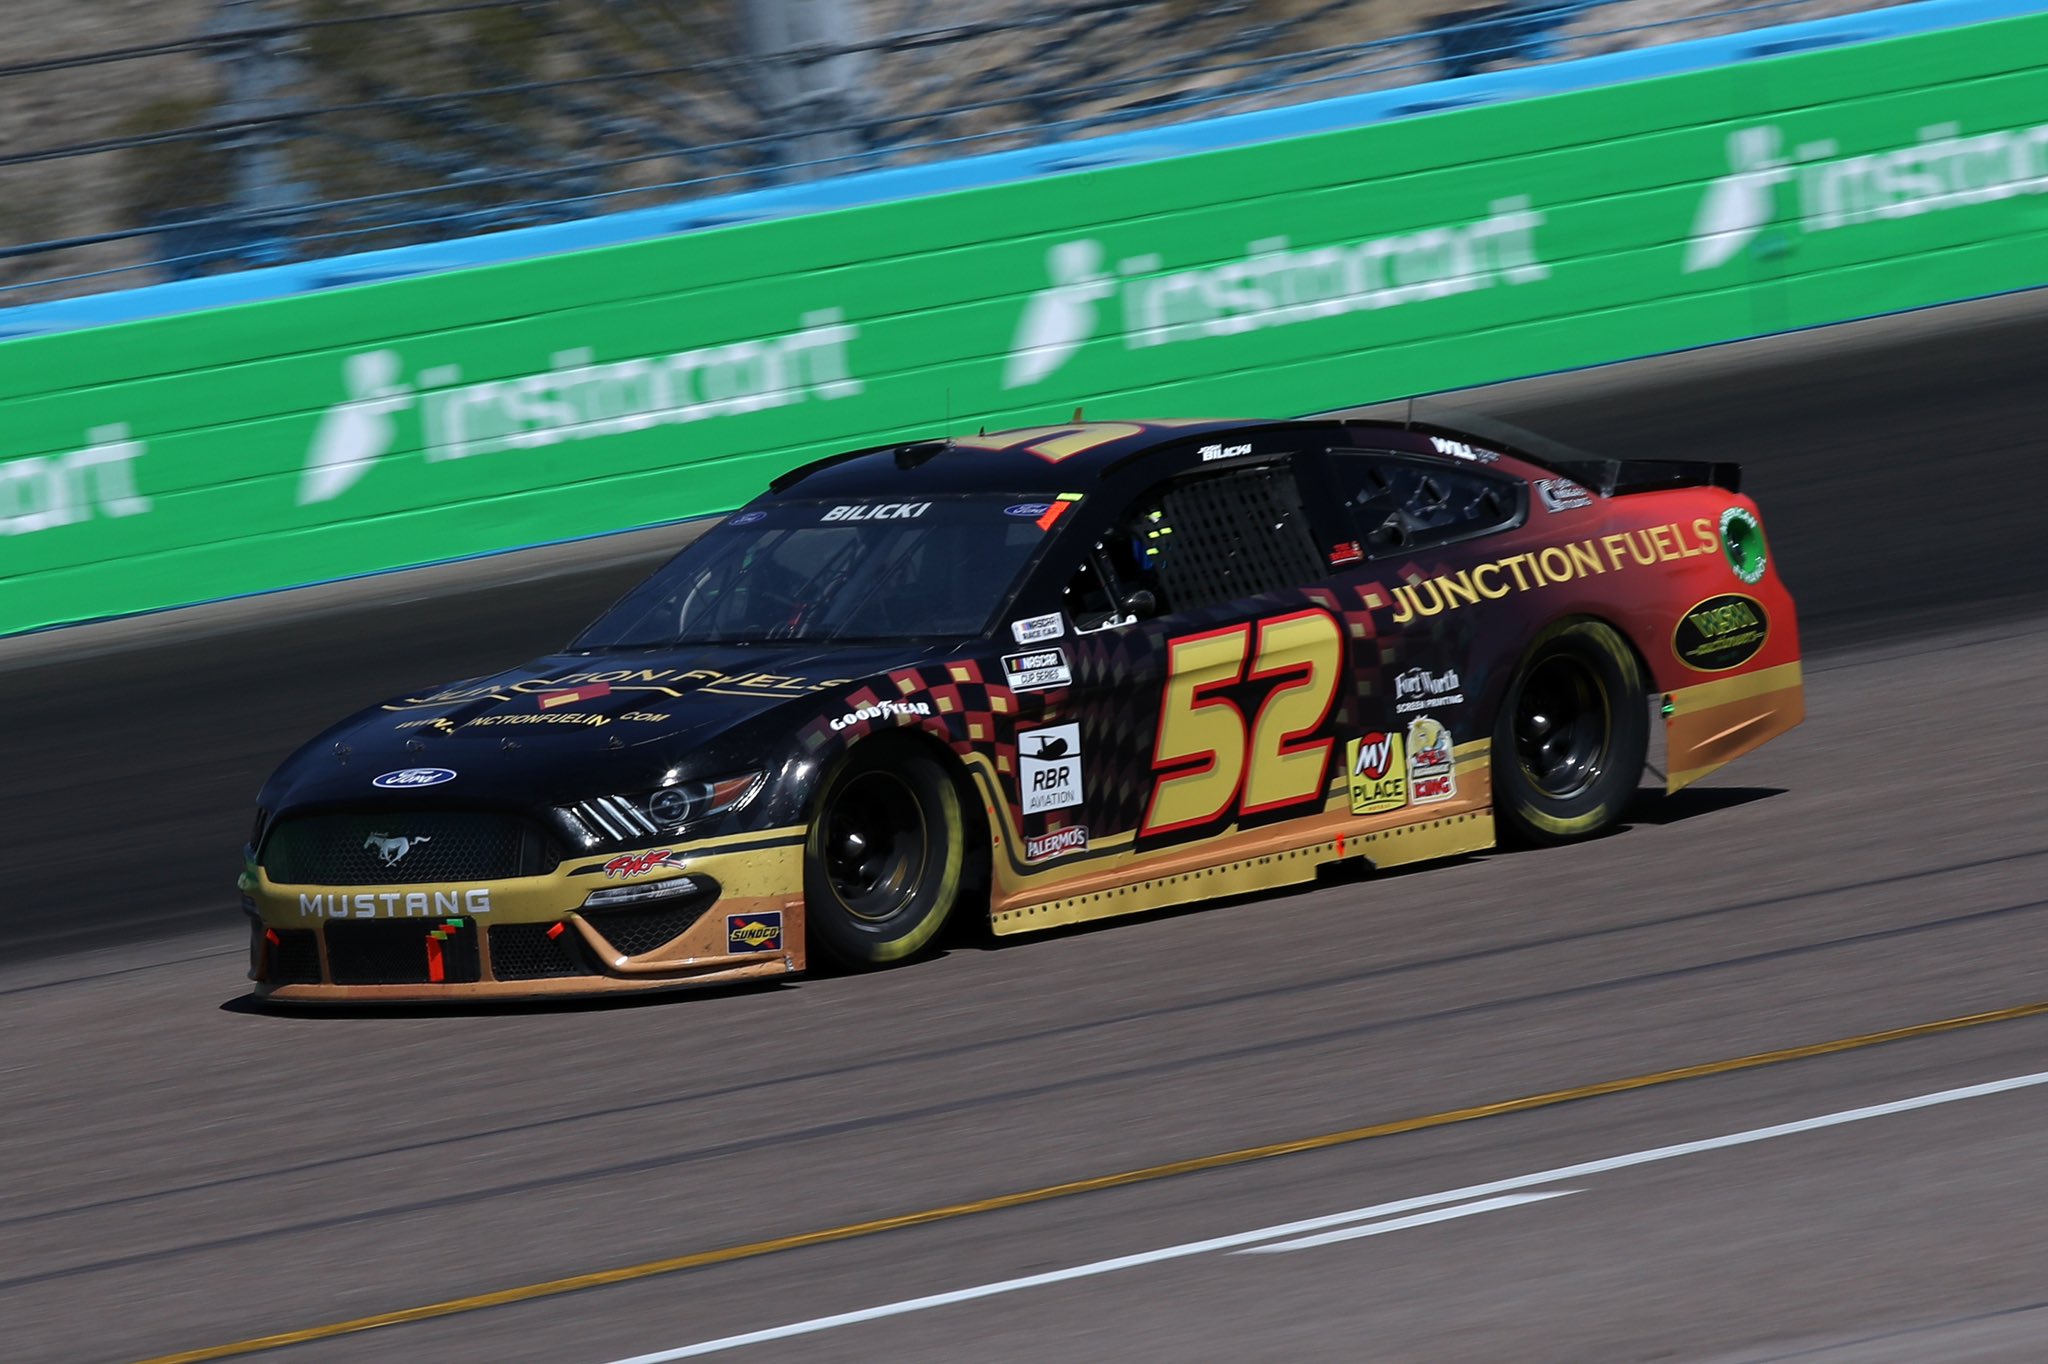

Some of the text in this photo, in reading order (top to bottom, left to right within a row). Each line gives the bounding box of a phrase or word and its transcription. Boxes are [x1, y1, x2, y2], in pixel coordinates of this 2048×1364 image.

[1117, 194, 1552, 350] instacart
[416, 306, 865, 464] instacart
[820, 502, 933, 522] BILICKI
[1391, 539, 1606, 623] JUNCTION
[1601, 518, 1720, 571] FUELS
[1022, 626, 1058, 640] RACE CAR
[1023, 652, 1059, 670] NASCAR
[1020, 668, 1060, 684] CUP SERIES
[830, 700, 932, 731] GOODYEAR
[1138, 607, 1344, 838] 52
[1354, 732, 1393, 777] MY
[1033, 766, 1070, 793] RBR
[1352, 778, 1404, 804] PLACE
[1030, 790, 1075, 810] AVIATION
[1027, 828, 1086, 858] PALERMO'S
[300, 888, 490, 918] MUSTANG
[731, 927, 779, 941] SUNOCO
